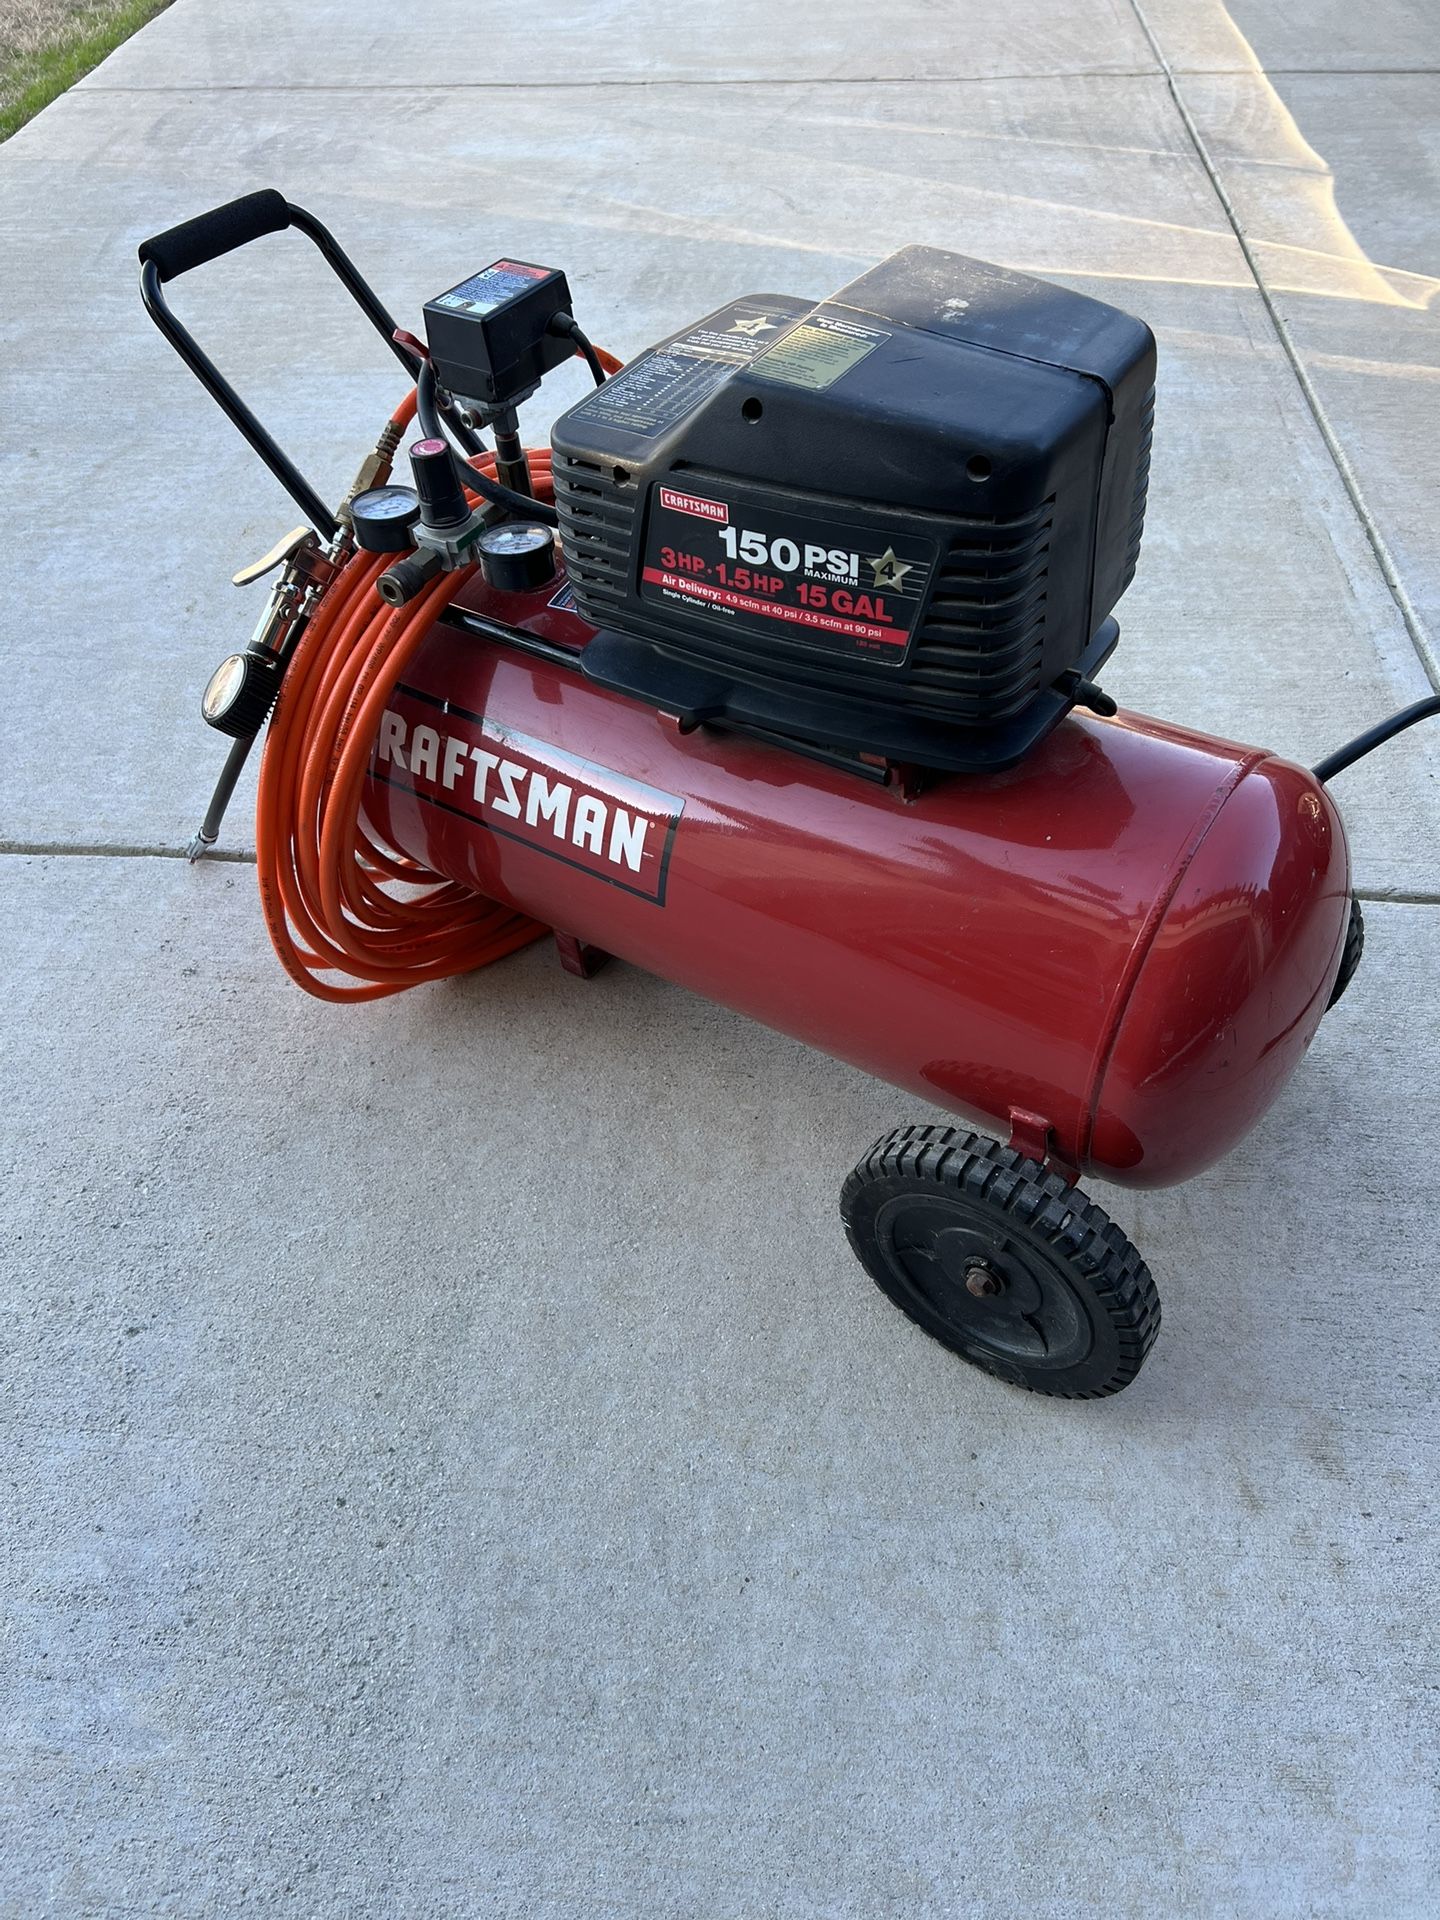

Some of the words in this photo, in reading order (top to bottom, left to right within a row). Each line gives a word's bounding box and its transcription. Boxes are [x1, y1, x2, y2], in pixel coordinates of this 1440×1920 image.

[664, 493, 725, 518] CRAFTSMAN
[718, 525, 800, 572] 150
[804, 544, 859, 578] PSI
[804, 568, 858, 586] MAXIMUM
[880, 561, 896, 580] 4
[662, 588, 680, 600] Single
[681, 593, 706, 607] Cylinder
[662, 574, 676, 585] Air
[678, 578, 722, 600] Delivery:
[725, 594, 738, 604] 4.9
[739, 597, 760, 610] scfm
[761, 603, 770, 613] at
[771, 605, 783, 615] 40
[784, 609, 797, 619] psi
[804, 613, 818, 624] 3.5
[820, 617, 842, 629] scfm
[843, 623, 853, 632] at
[854, 624, 867, 634] 90
[867, 627, 882, 638] psi
[796, 582, 827, 608] 15
[831, 589, 894, 622] GAL
[378, 708, 649, 873] RAFTSMAN
